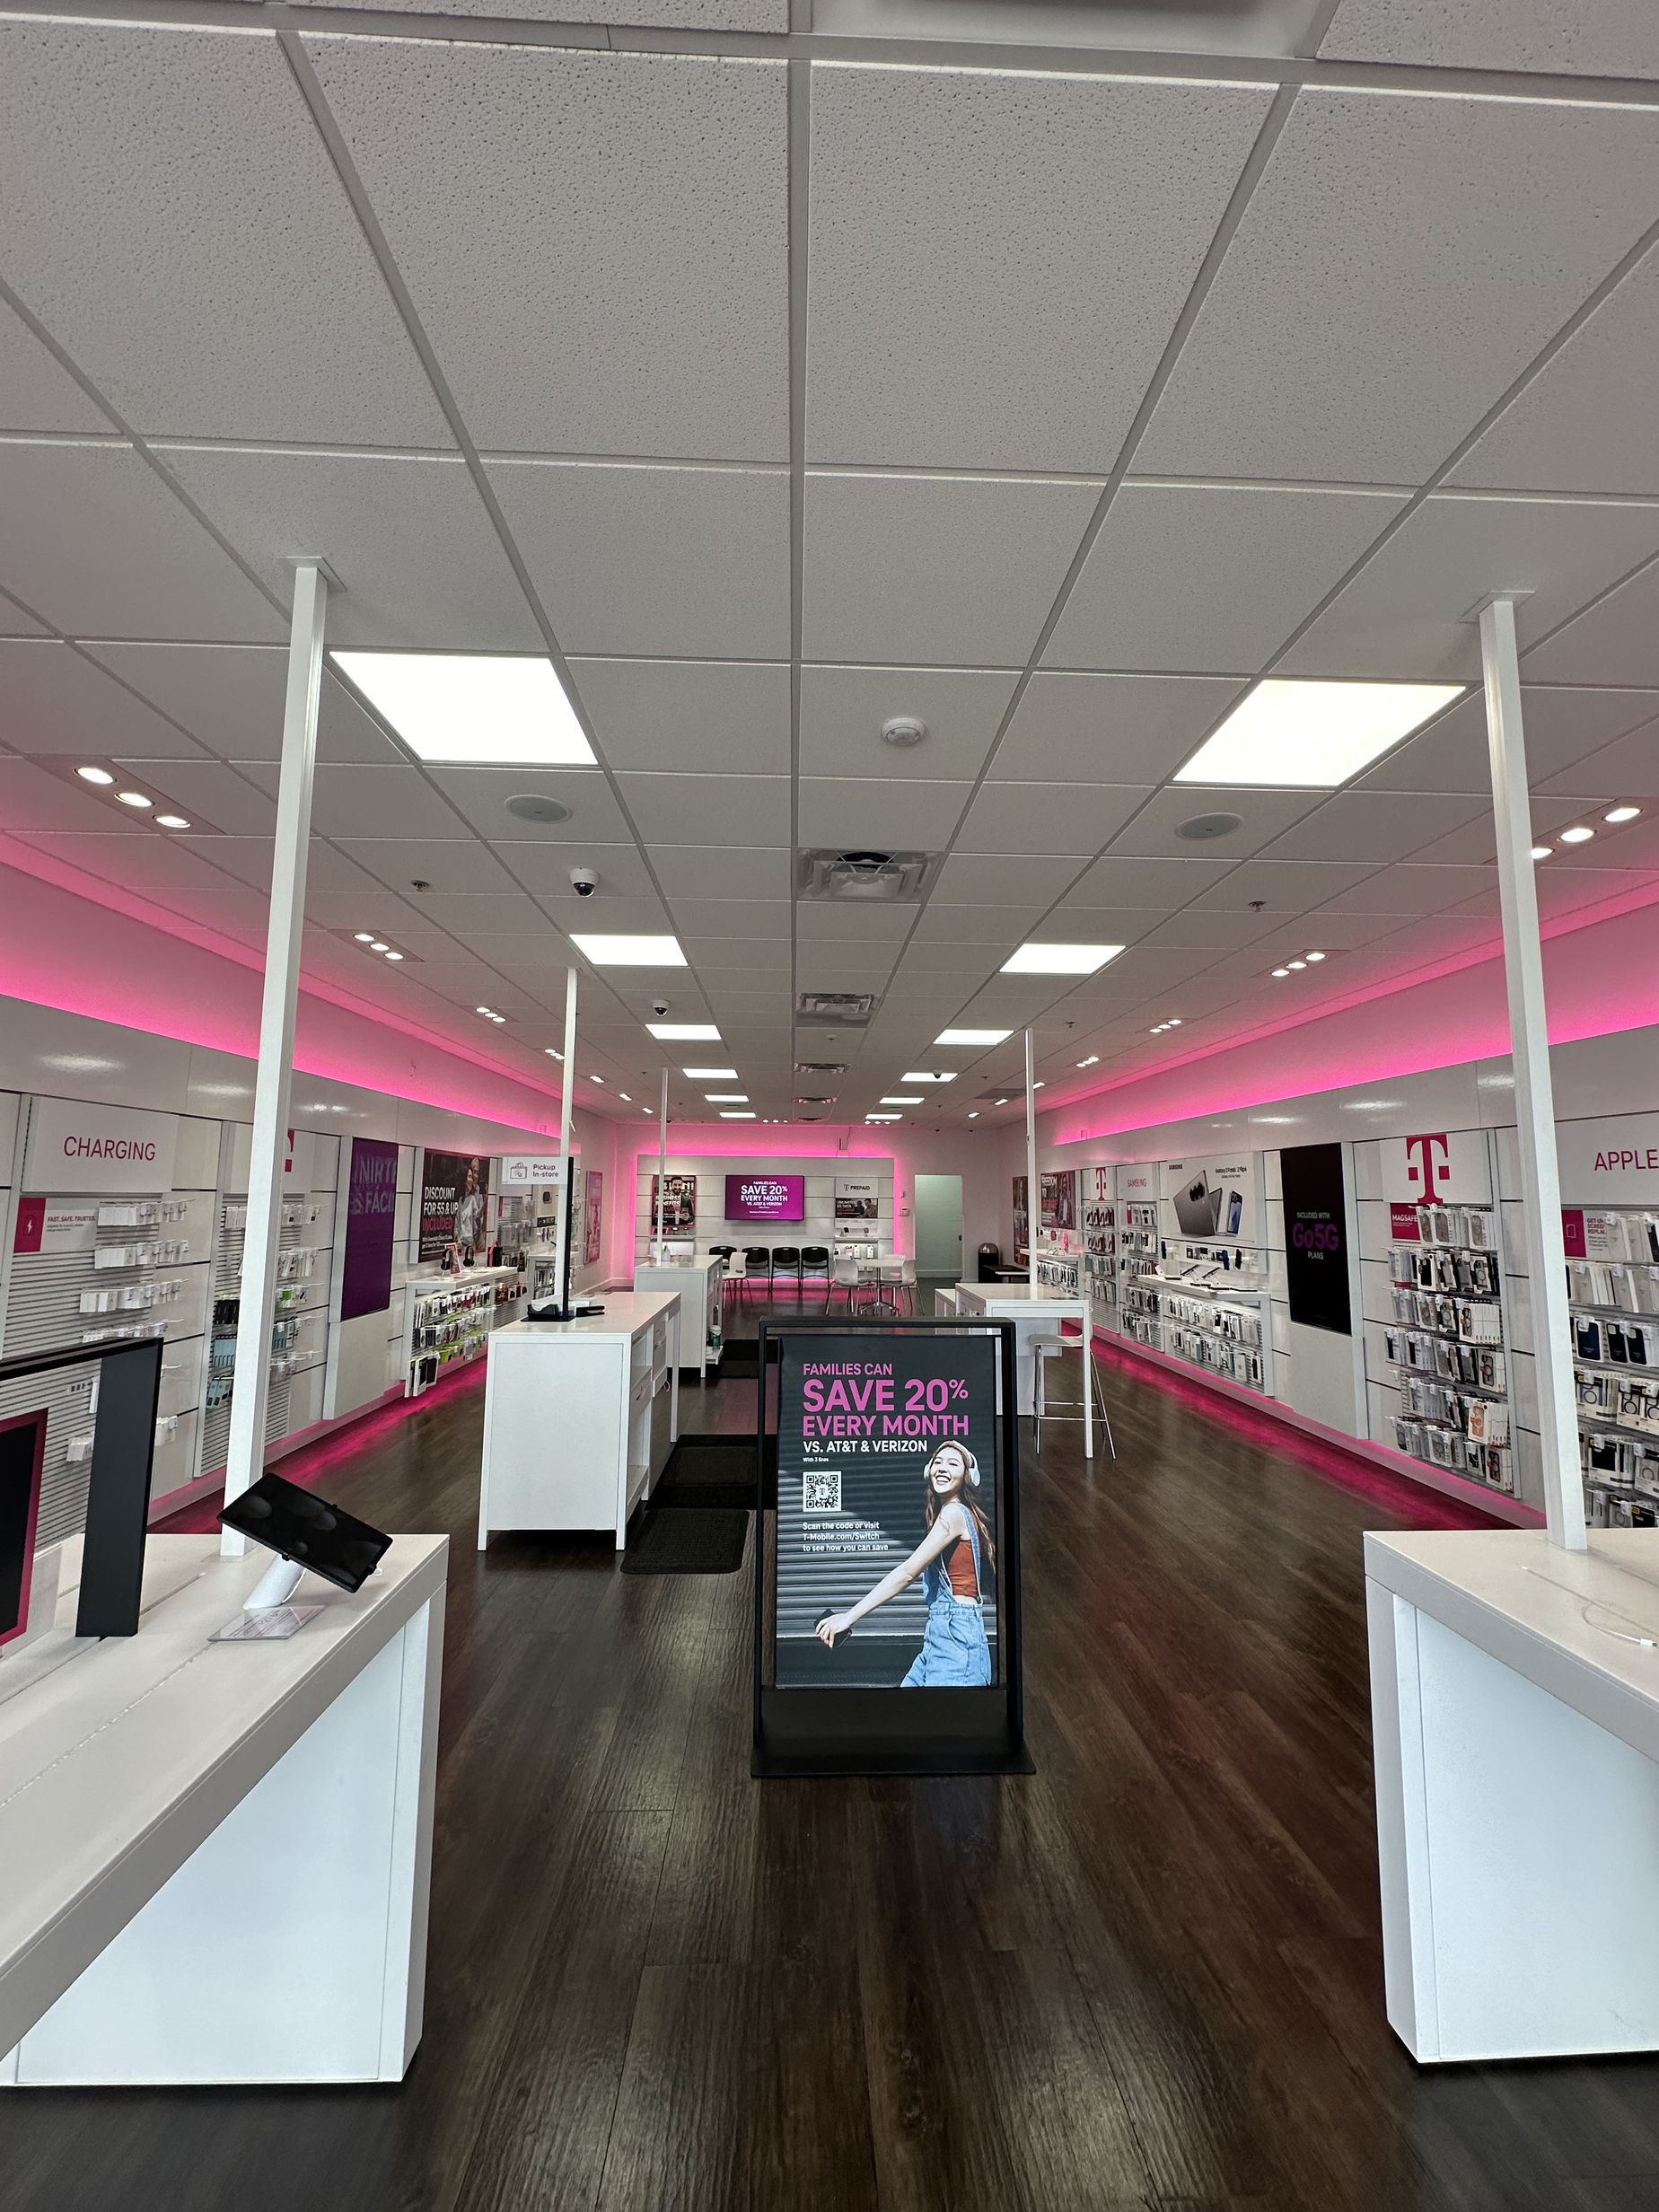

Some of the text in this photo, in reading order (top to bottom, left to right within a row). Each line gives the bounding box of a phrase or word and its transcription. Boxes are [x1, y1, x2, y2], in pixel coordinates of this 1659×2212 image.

[64, 1136, 155, 1161] CHARGING
[1594, 1149, 1659, 1171] APPLE
[1128, 1178, 1146, 1188] SAMSUNG
[425, 1186, 456, 1200] DISCOUNT
[741, 1185, 788, 1195] SAVE 20%
[423, 1201, 459, 1216] FOR 55 & UP
[422, 1216, 453, 1231] INCLUDED
[1392, 1214, 1418, 1222] MAGSAFE
[1293, 1222, 1339, 1251] Go5G
[1307, 1251, 1324, 1260] PLANS
[803, 1363, 892, 1375] FAMILIES CAN
[803, 1378, 969, 1412] SAVE 20%
[803, 1415, 969, 1436] EVERY MONTH
[803, 1440, 927, 1453] VS. AT&T & VERIZON
[803, 1522, 821, 1530] Scan
[822, 1522, 834, 1530] the
[835, 1522, 854, 1530] code
[862, 1521, 880, 1529] visit
[803, 1532, 880, 1540] T-Mobile.com/Switch
